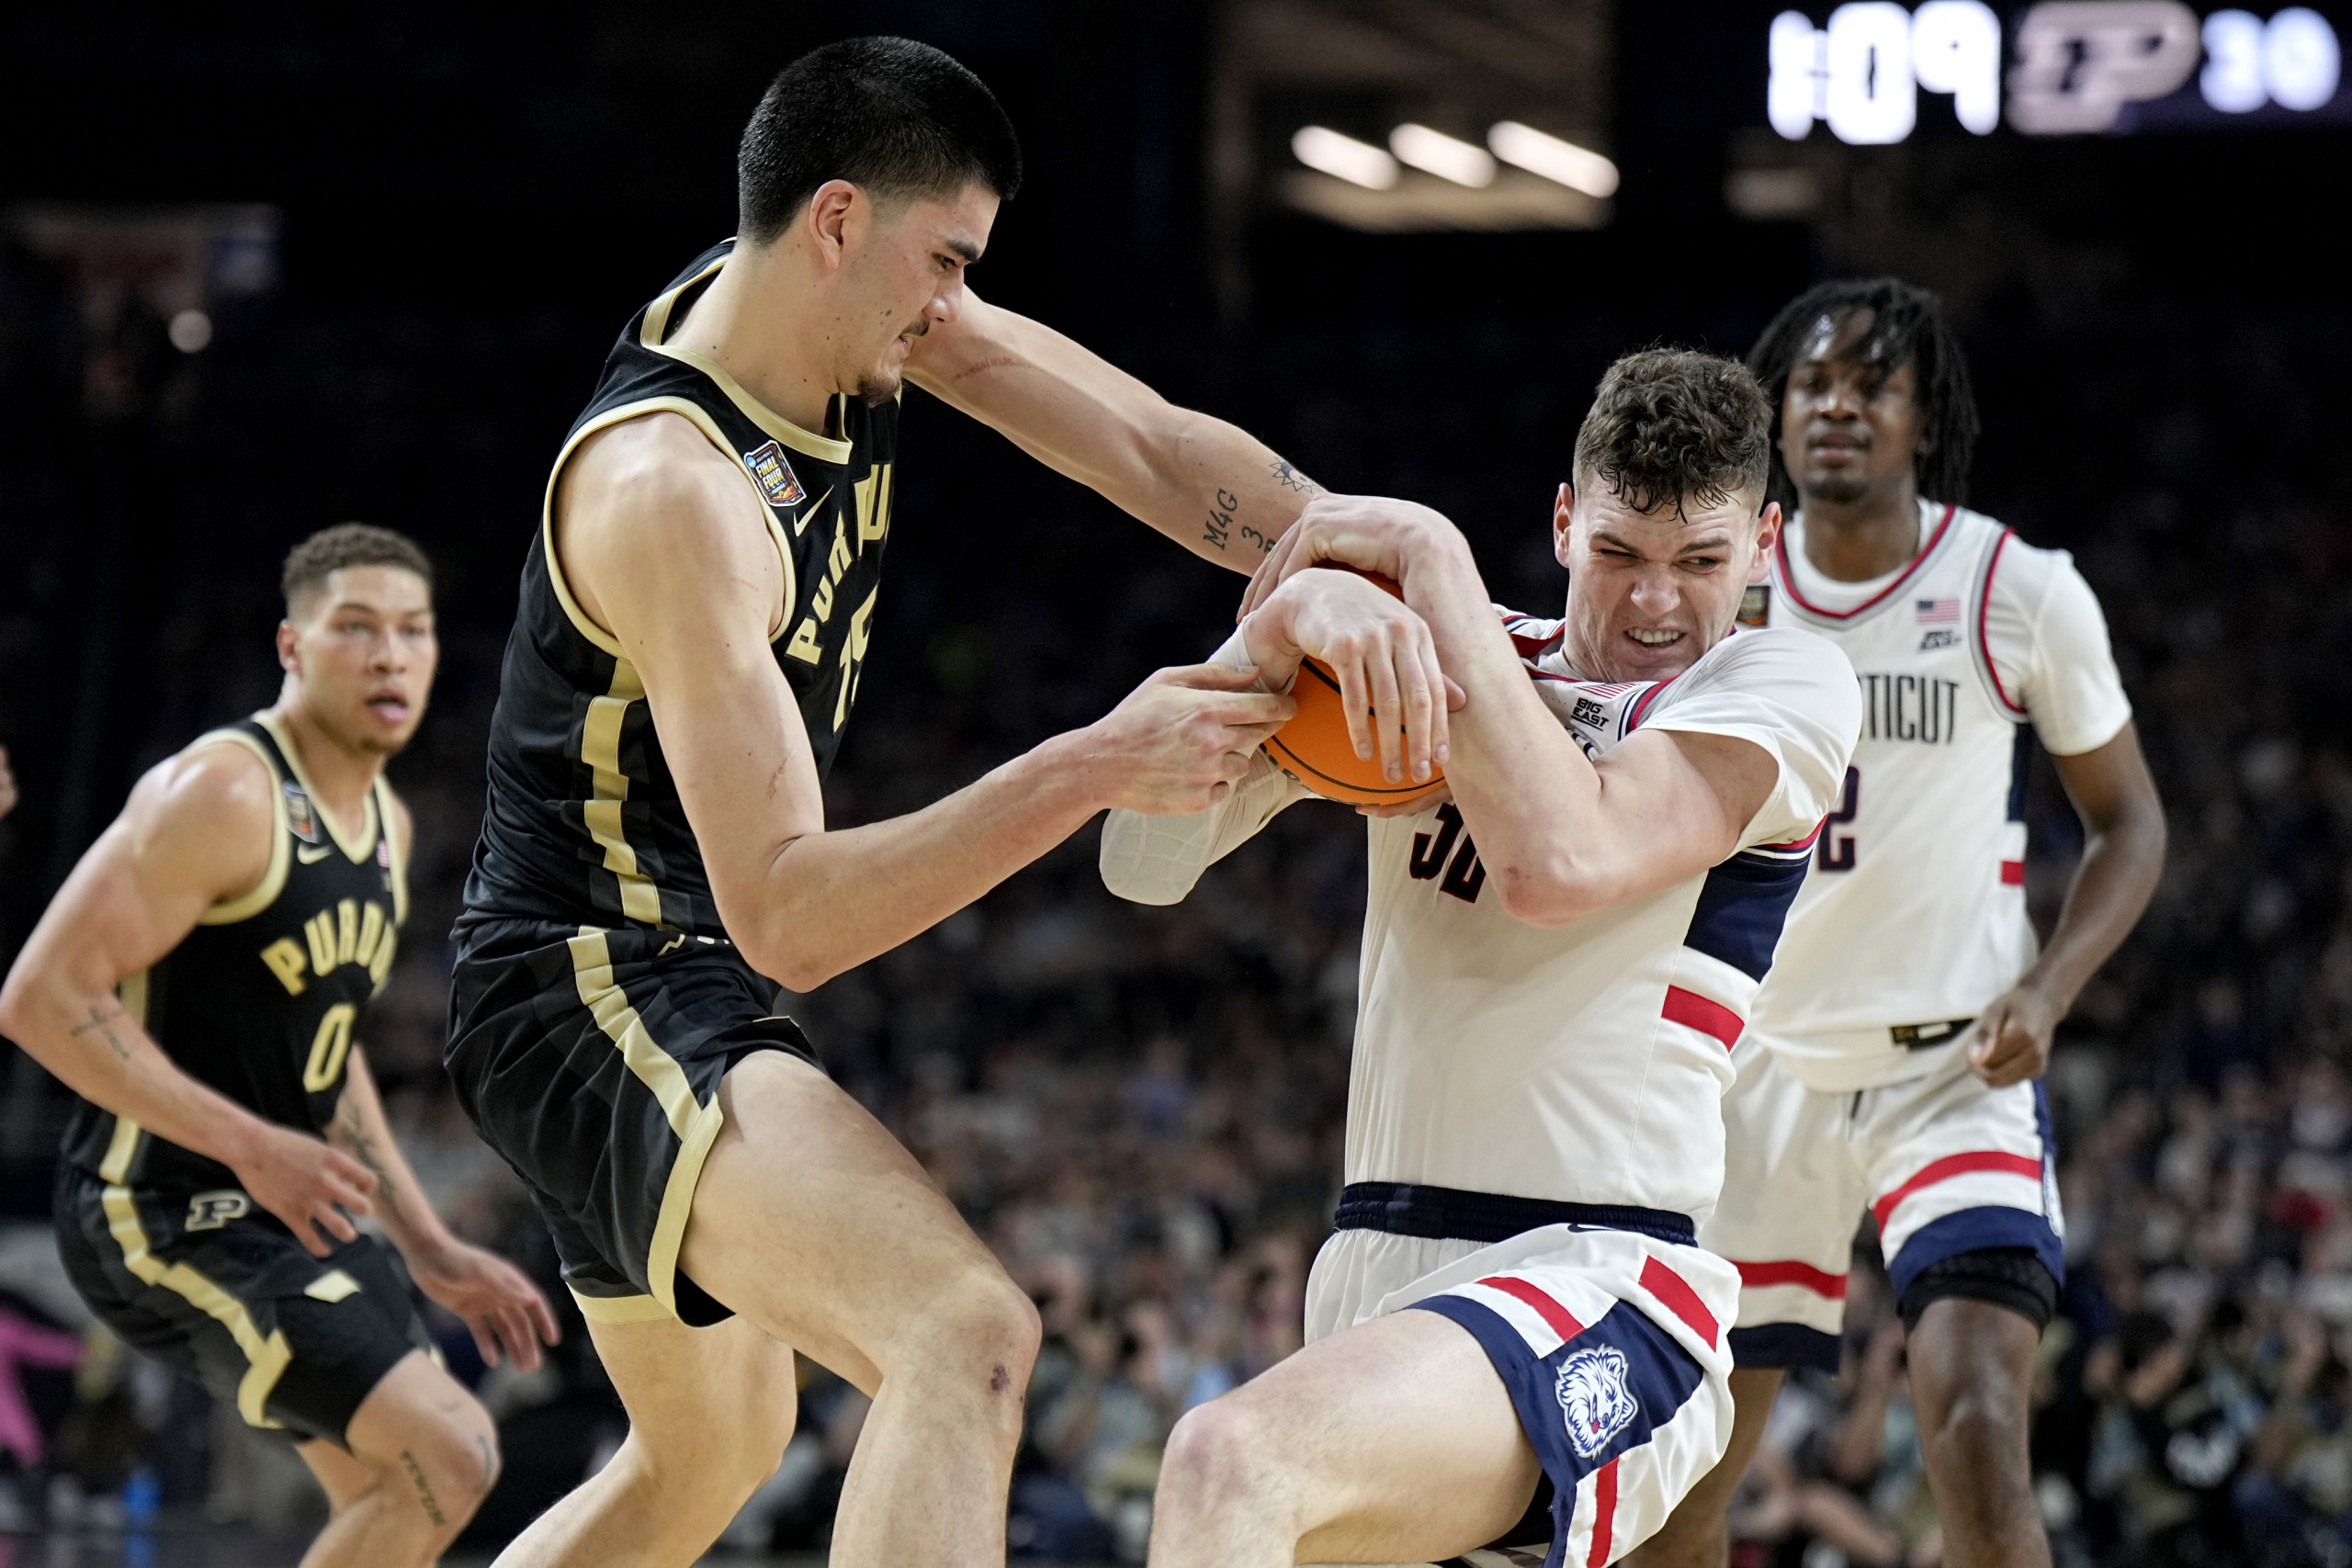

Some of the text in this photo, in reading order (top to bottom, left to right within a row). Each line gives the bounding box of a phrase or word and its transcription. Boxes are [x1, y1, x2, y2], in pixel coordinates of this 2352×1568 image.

[755, 456, 779, 478] FINAL
[762, 467, 785, 490] FOUR
[1203, 488, 1238, 551] M4G
[1241, 525, 1263, 549] 3
[1572, 706, 1609, 728] EAST
[1577, 697, 1604, 714] BIG
[1857, 671, 1960, 746] TICUT
[303, 1003, 355, 1092] 0
[185, 1190, 247, 1232] P
